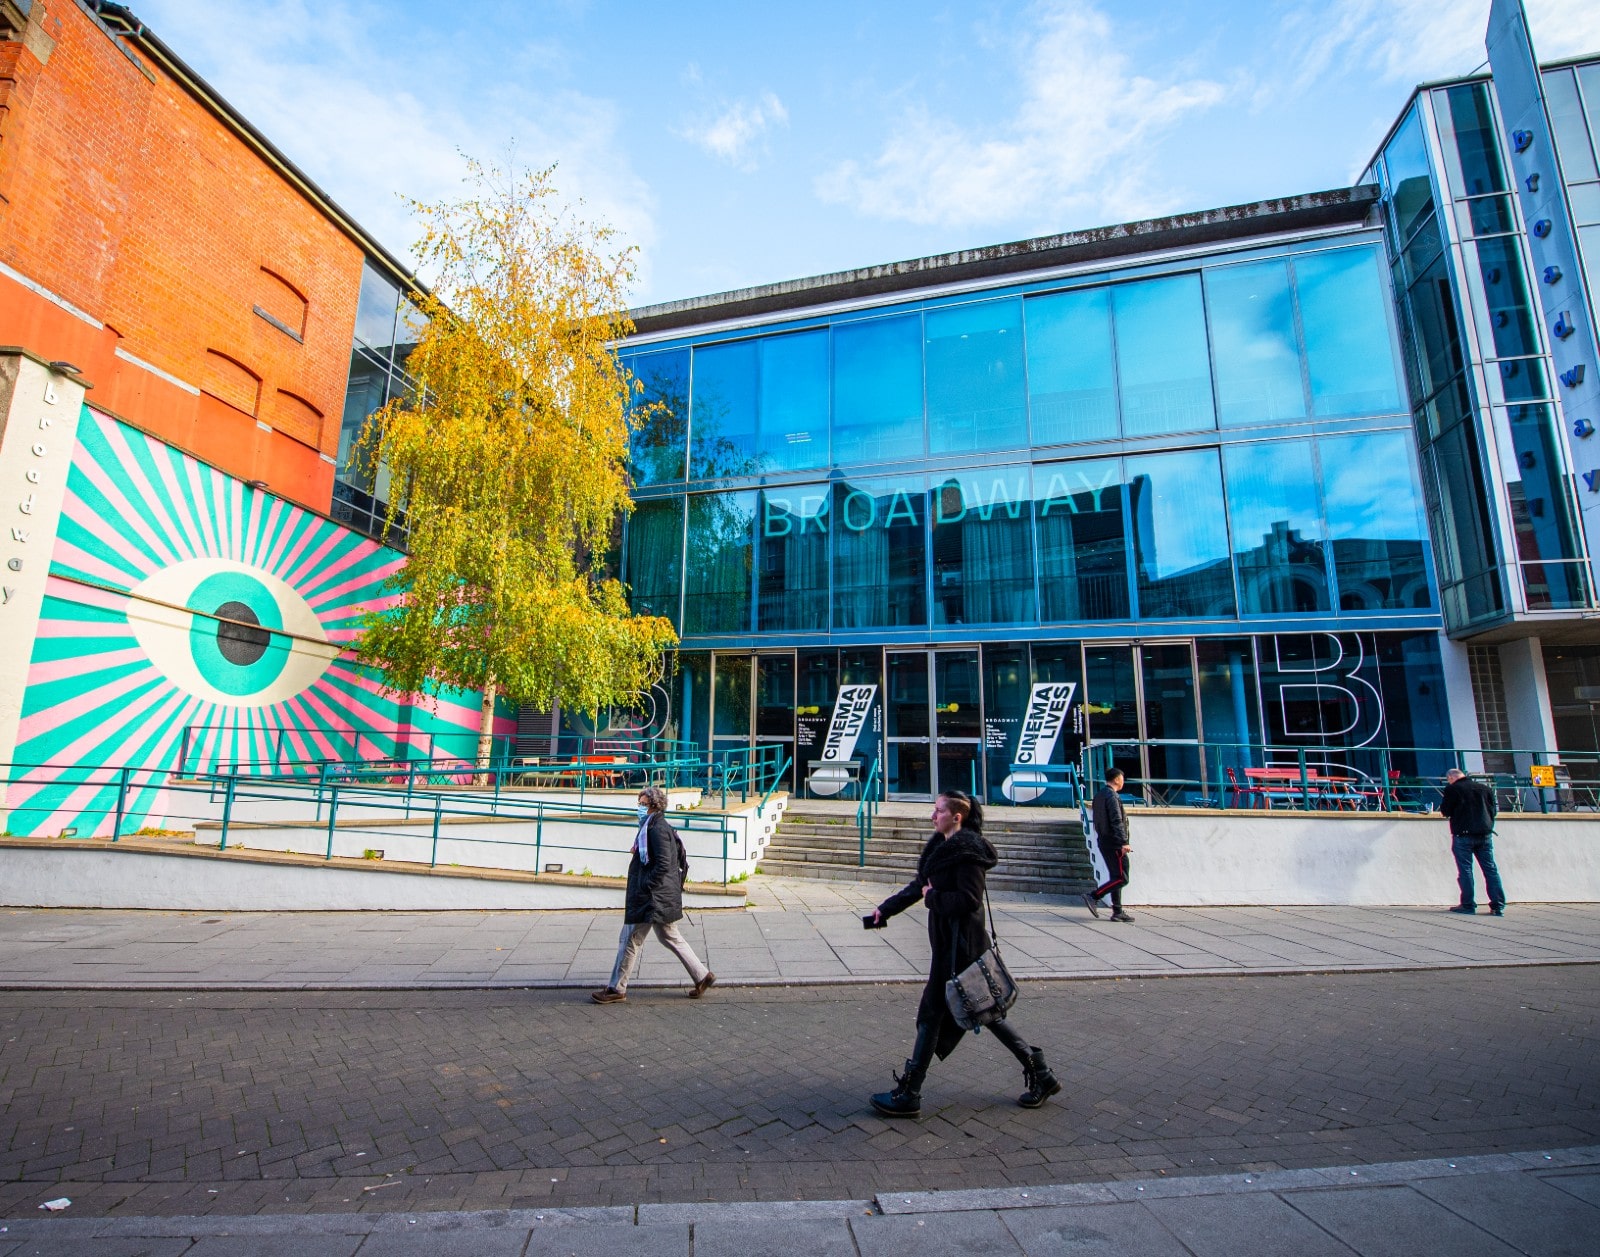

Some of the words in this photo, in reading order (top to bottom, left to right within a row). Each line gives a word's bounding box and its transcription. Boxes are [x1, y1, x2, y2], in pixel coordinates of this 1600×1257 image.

[1513, 129, 1600, 492] broadway
[2, 381, 59, 605] broadway
[764, 468, 1114, 538] BROADWAY
[824, 687, 858, 760] CINEMA
[844, 687, 872, 737] LIVES
[1017, 685, 1054, 764] CINEMA
[1040, 685, 1071, 739] LIVES
